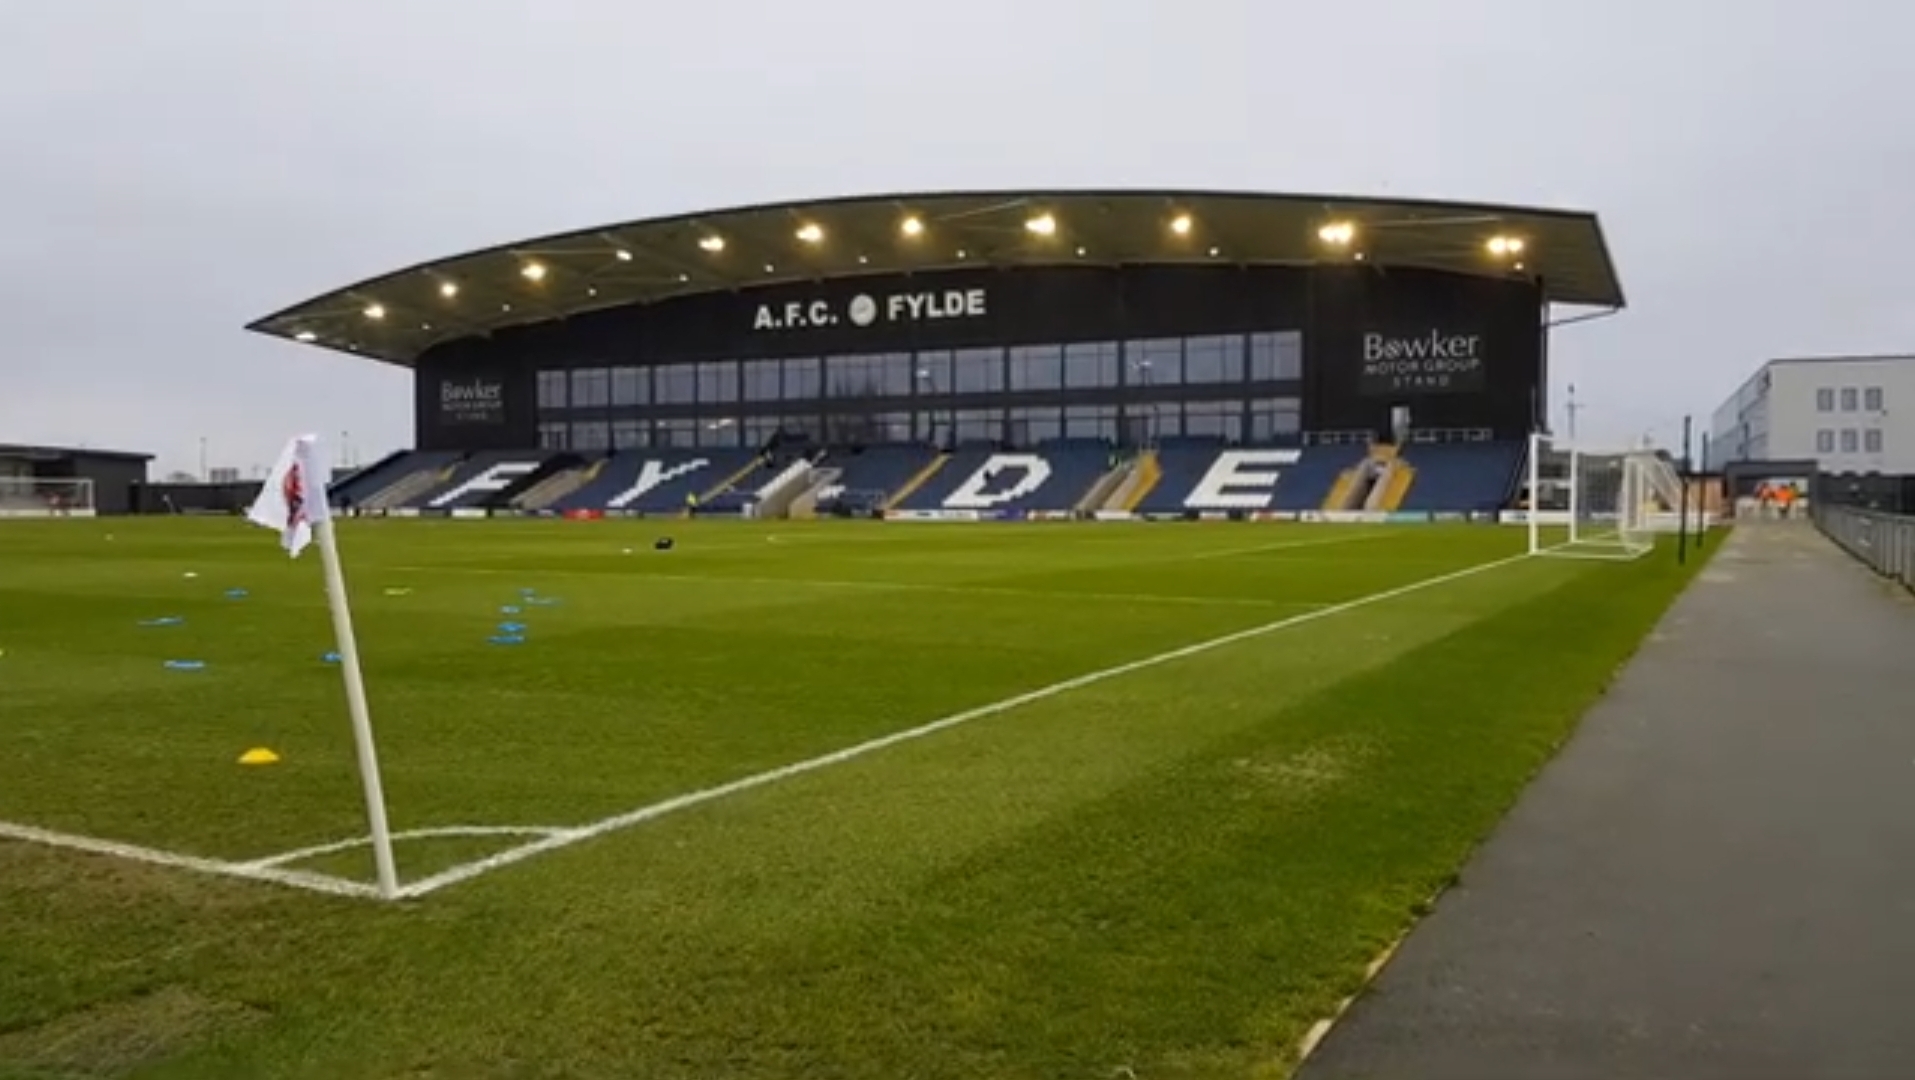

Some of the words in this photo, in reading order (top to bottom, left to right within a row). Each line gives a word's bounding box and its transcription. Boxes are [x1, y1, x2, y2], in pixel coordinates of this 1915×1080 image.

[754, 300, 838, 330] A.F.C.
[887, 289, 986, 321] FYLDE
[1363, 328, 1479, 361] Bowker
[1363, 361, 1419, 375] MOTOR
[1423, 358, 1481, 373] GROUP
